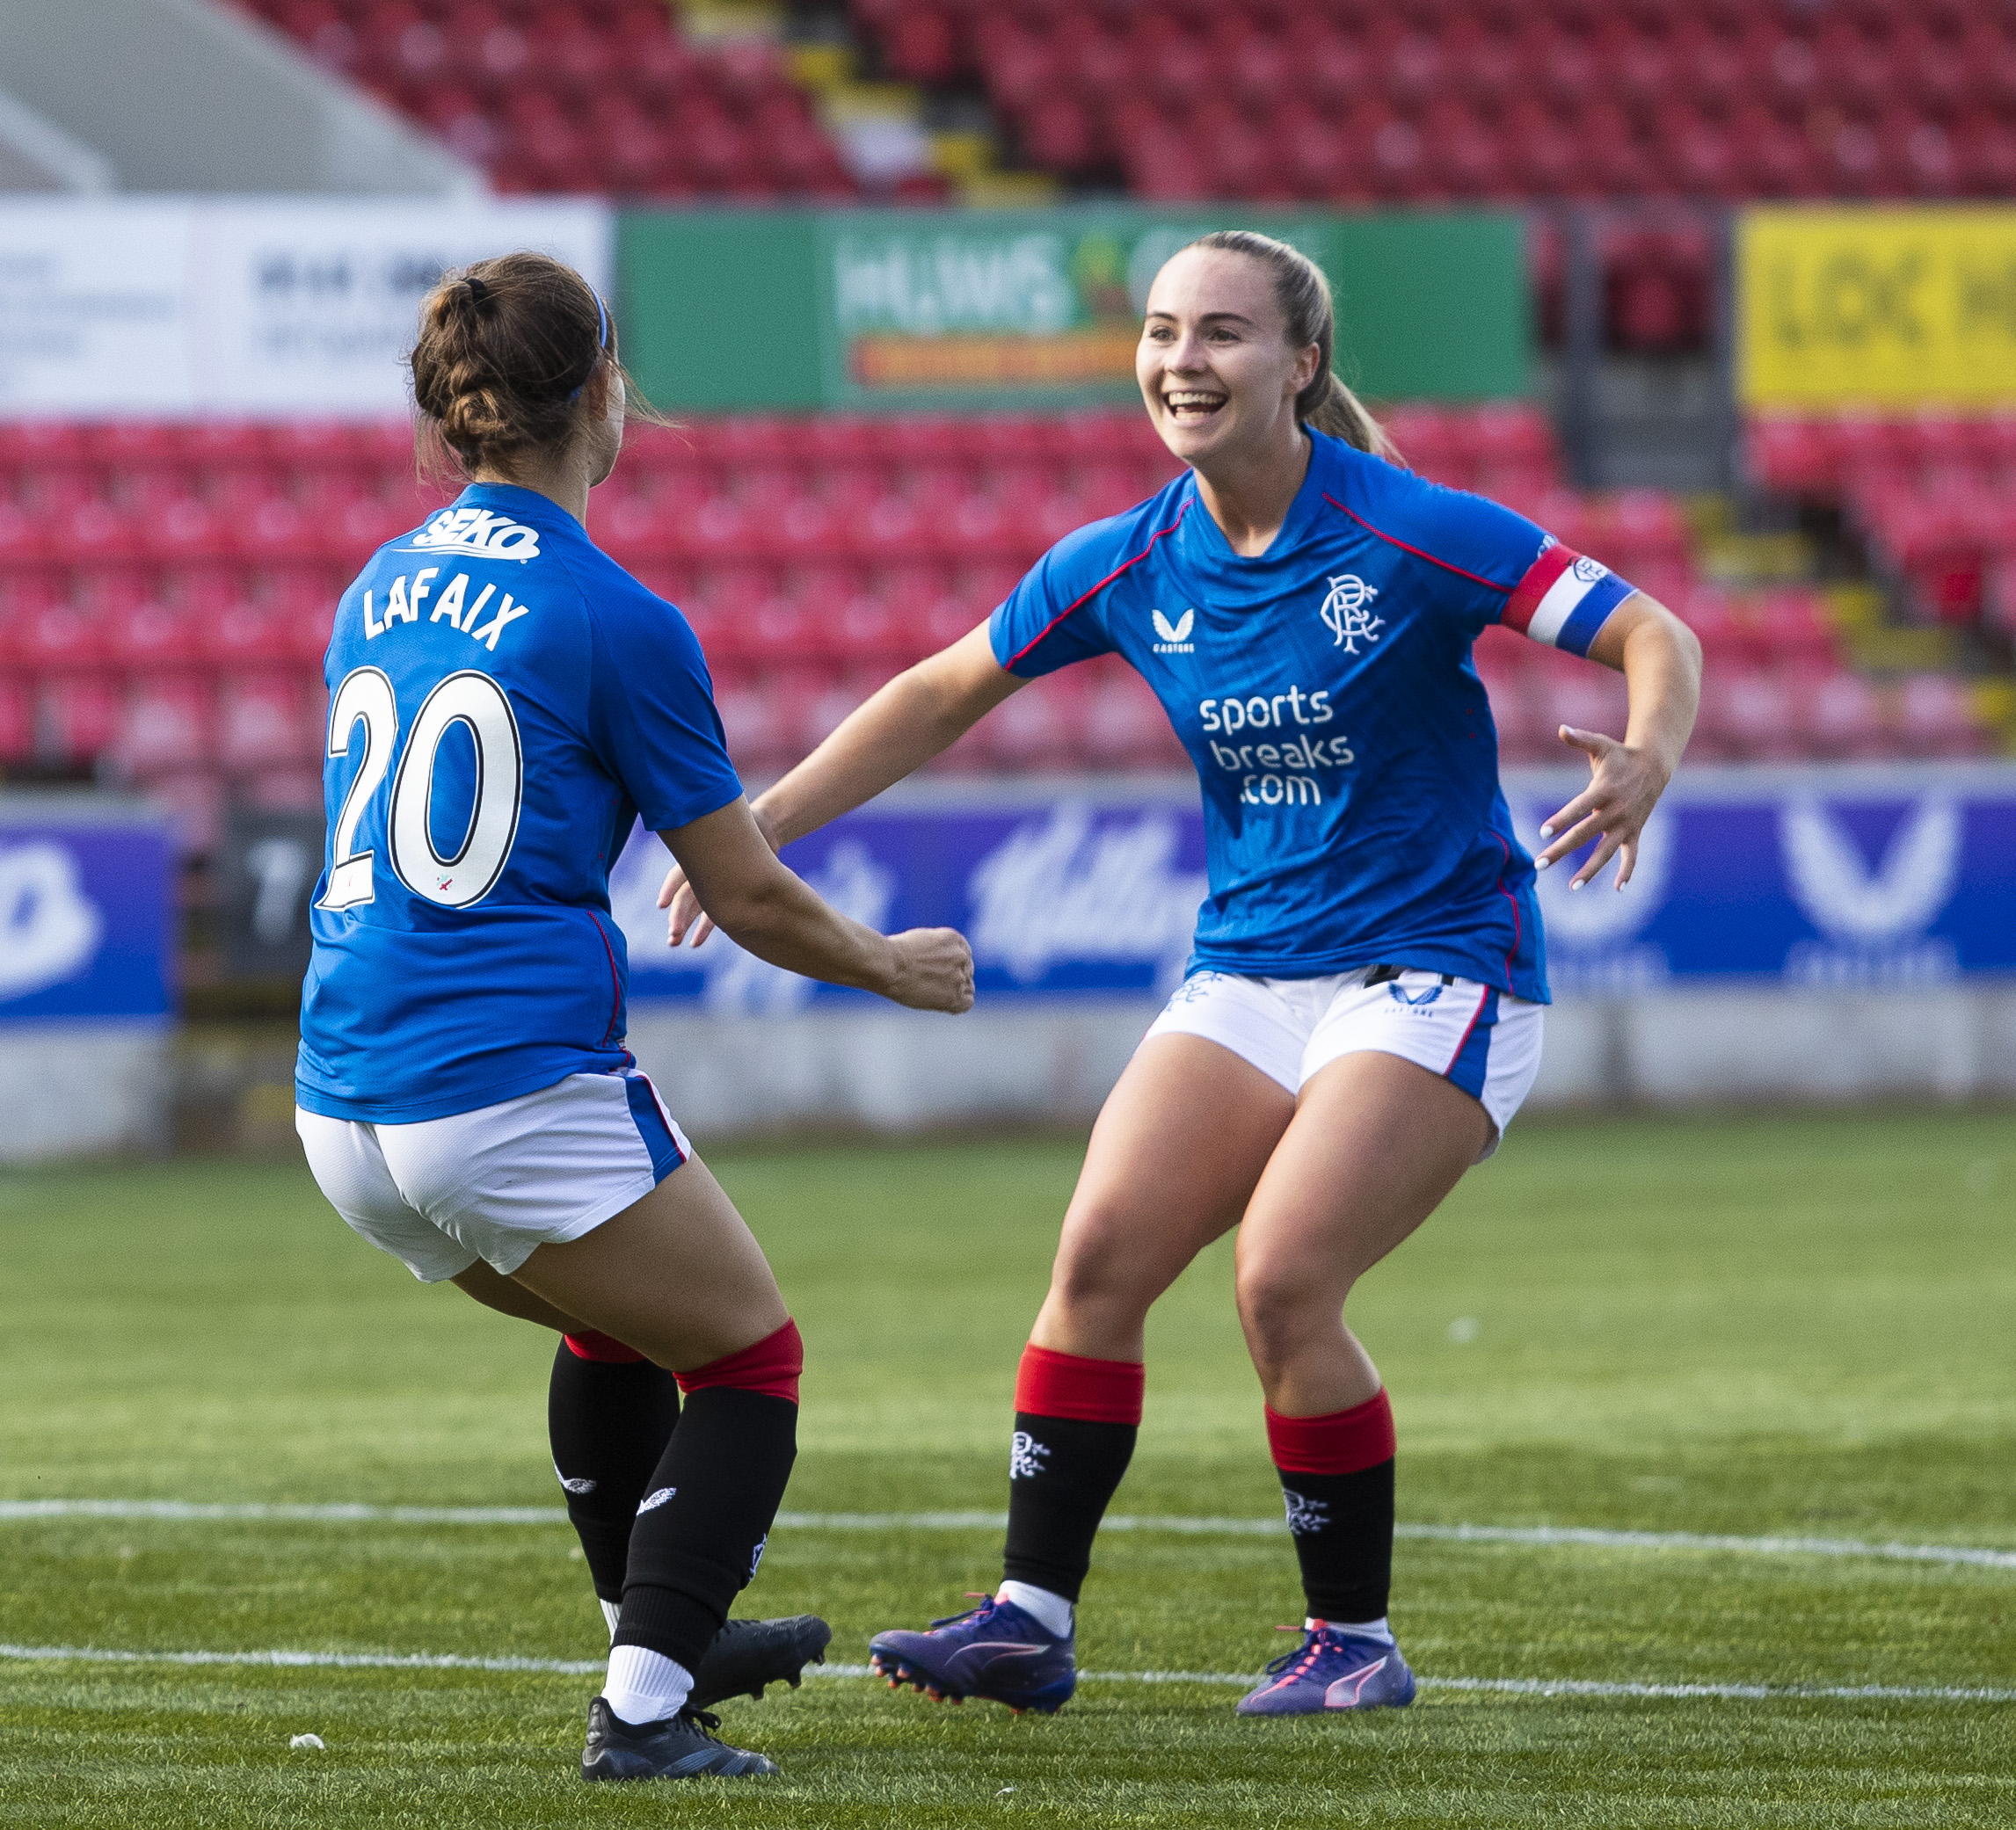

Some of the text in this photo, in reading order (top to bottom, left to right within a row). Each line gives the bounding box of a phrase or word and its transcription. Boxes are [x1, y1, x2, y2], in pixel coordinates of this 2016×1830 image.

[411, 508, 541, 561] SEKO
[362, 566, 529, 652] LAFAIX
[1199, 685, 1334, 736] sports
[1210, 734, 1355, 771] breaks
[314, 664, 523, 912] 20
[1240, 773, 1321, 806] .com
